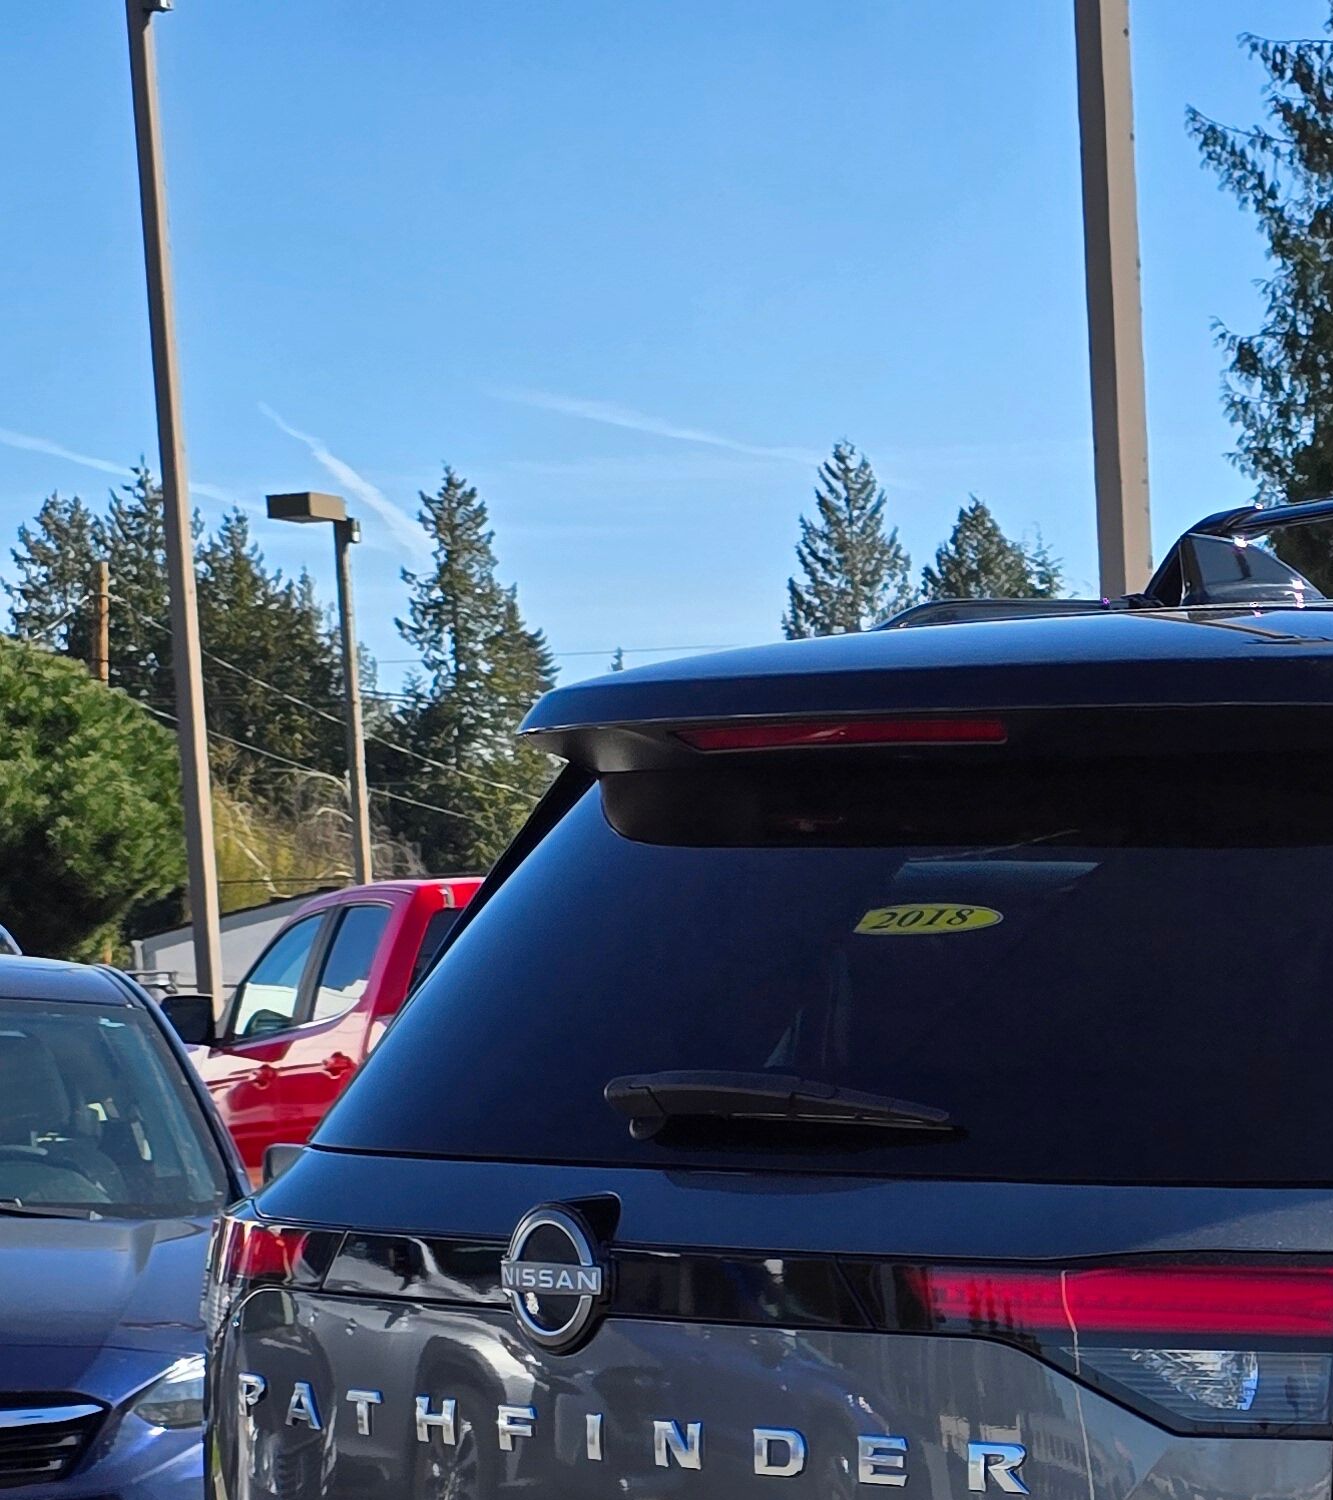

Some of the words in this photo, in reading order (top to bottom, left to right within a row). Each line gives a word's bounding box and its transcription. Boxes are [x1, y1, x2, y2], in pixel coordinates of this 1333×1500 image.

[870, 908, 974, 930] 2018
[502, 1266, 597, 1290] NISSAN
[237, 1371, 1030, 1495] PATHFINDER
